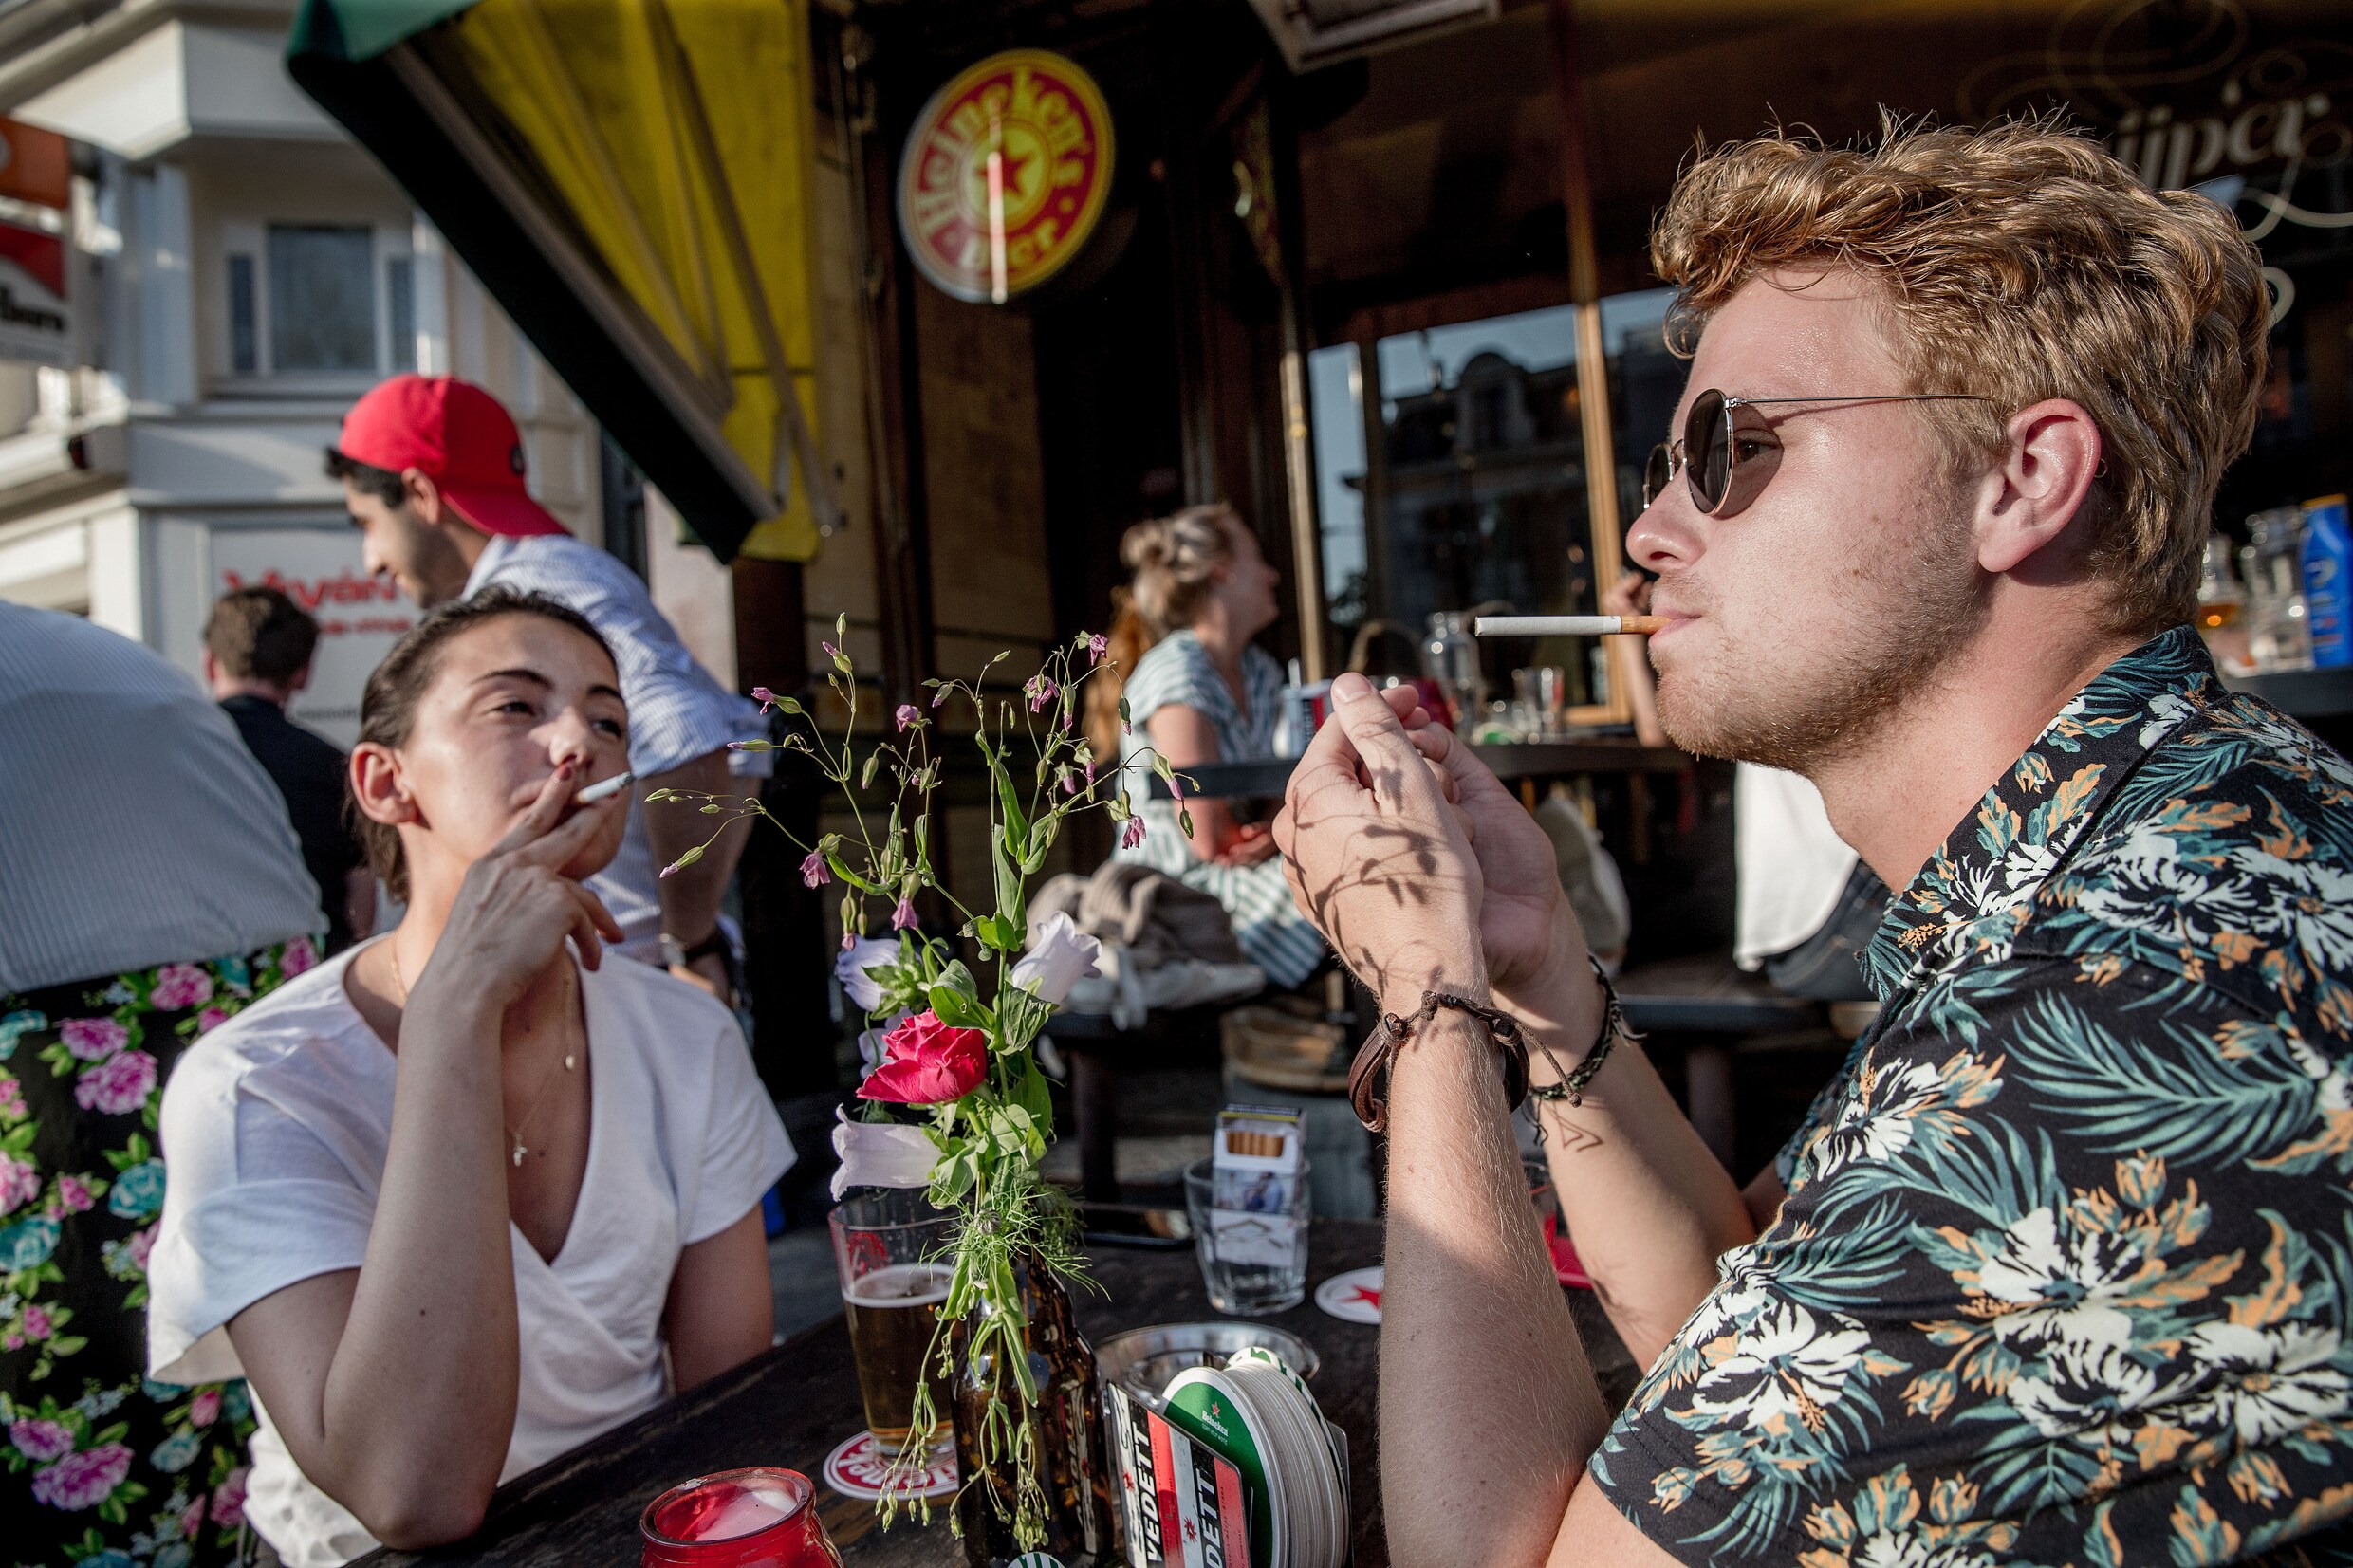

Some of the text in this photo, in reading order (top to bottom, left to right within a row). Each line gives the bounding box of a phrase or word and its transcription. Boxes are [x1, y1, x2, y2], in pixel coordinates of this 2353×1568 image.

[1201, 1410, 1229, 1437] Heineken
[1132, 1420, 1163, 1563] VEDETT
[1195, 1467, 1224, 1568] DETT
